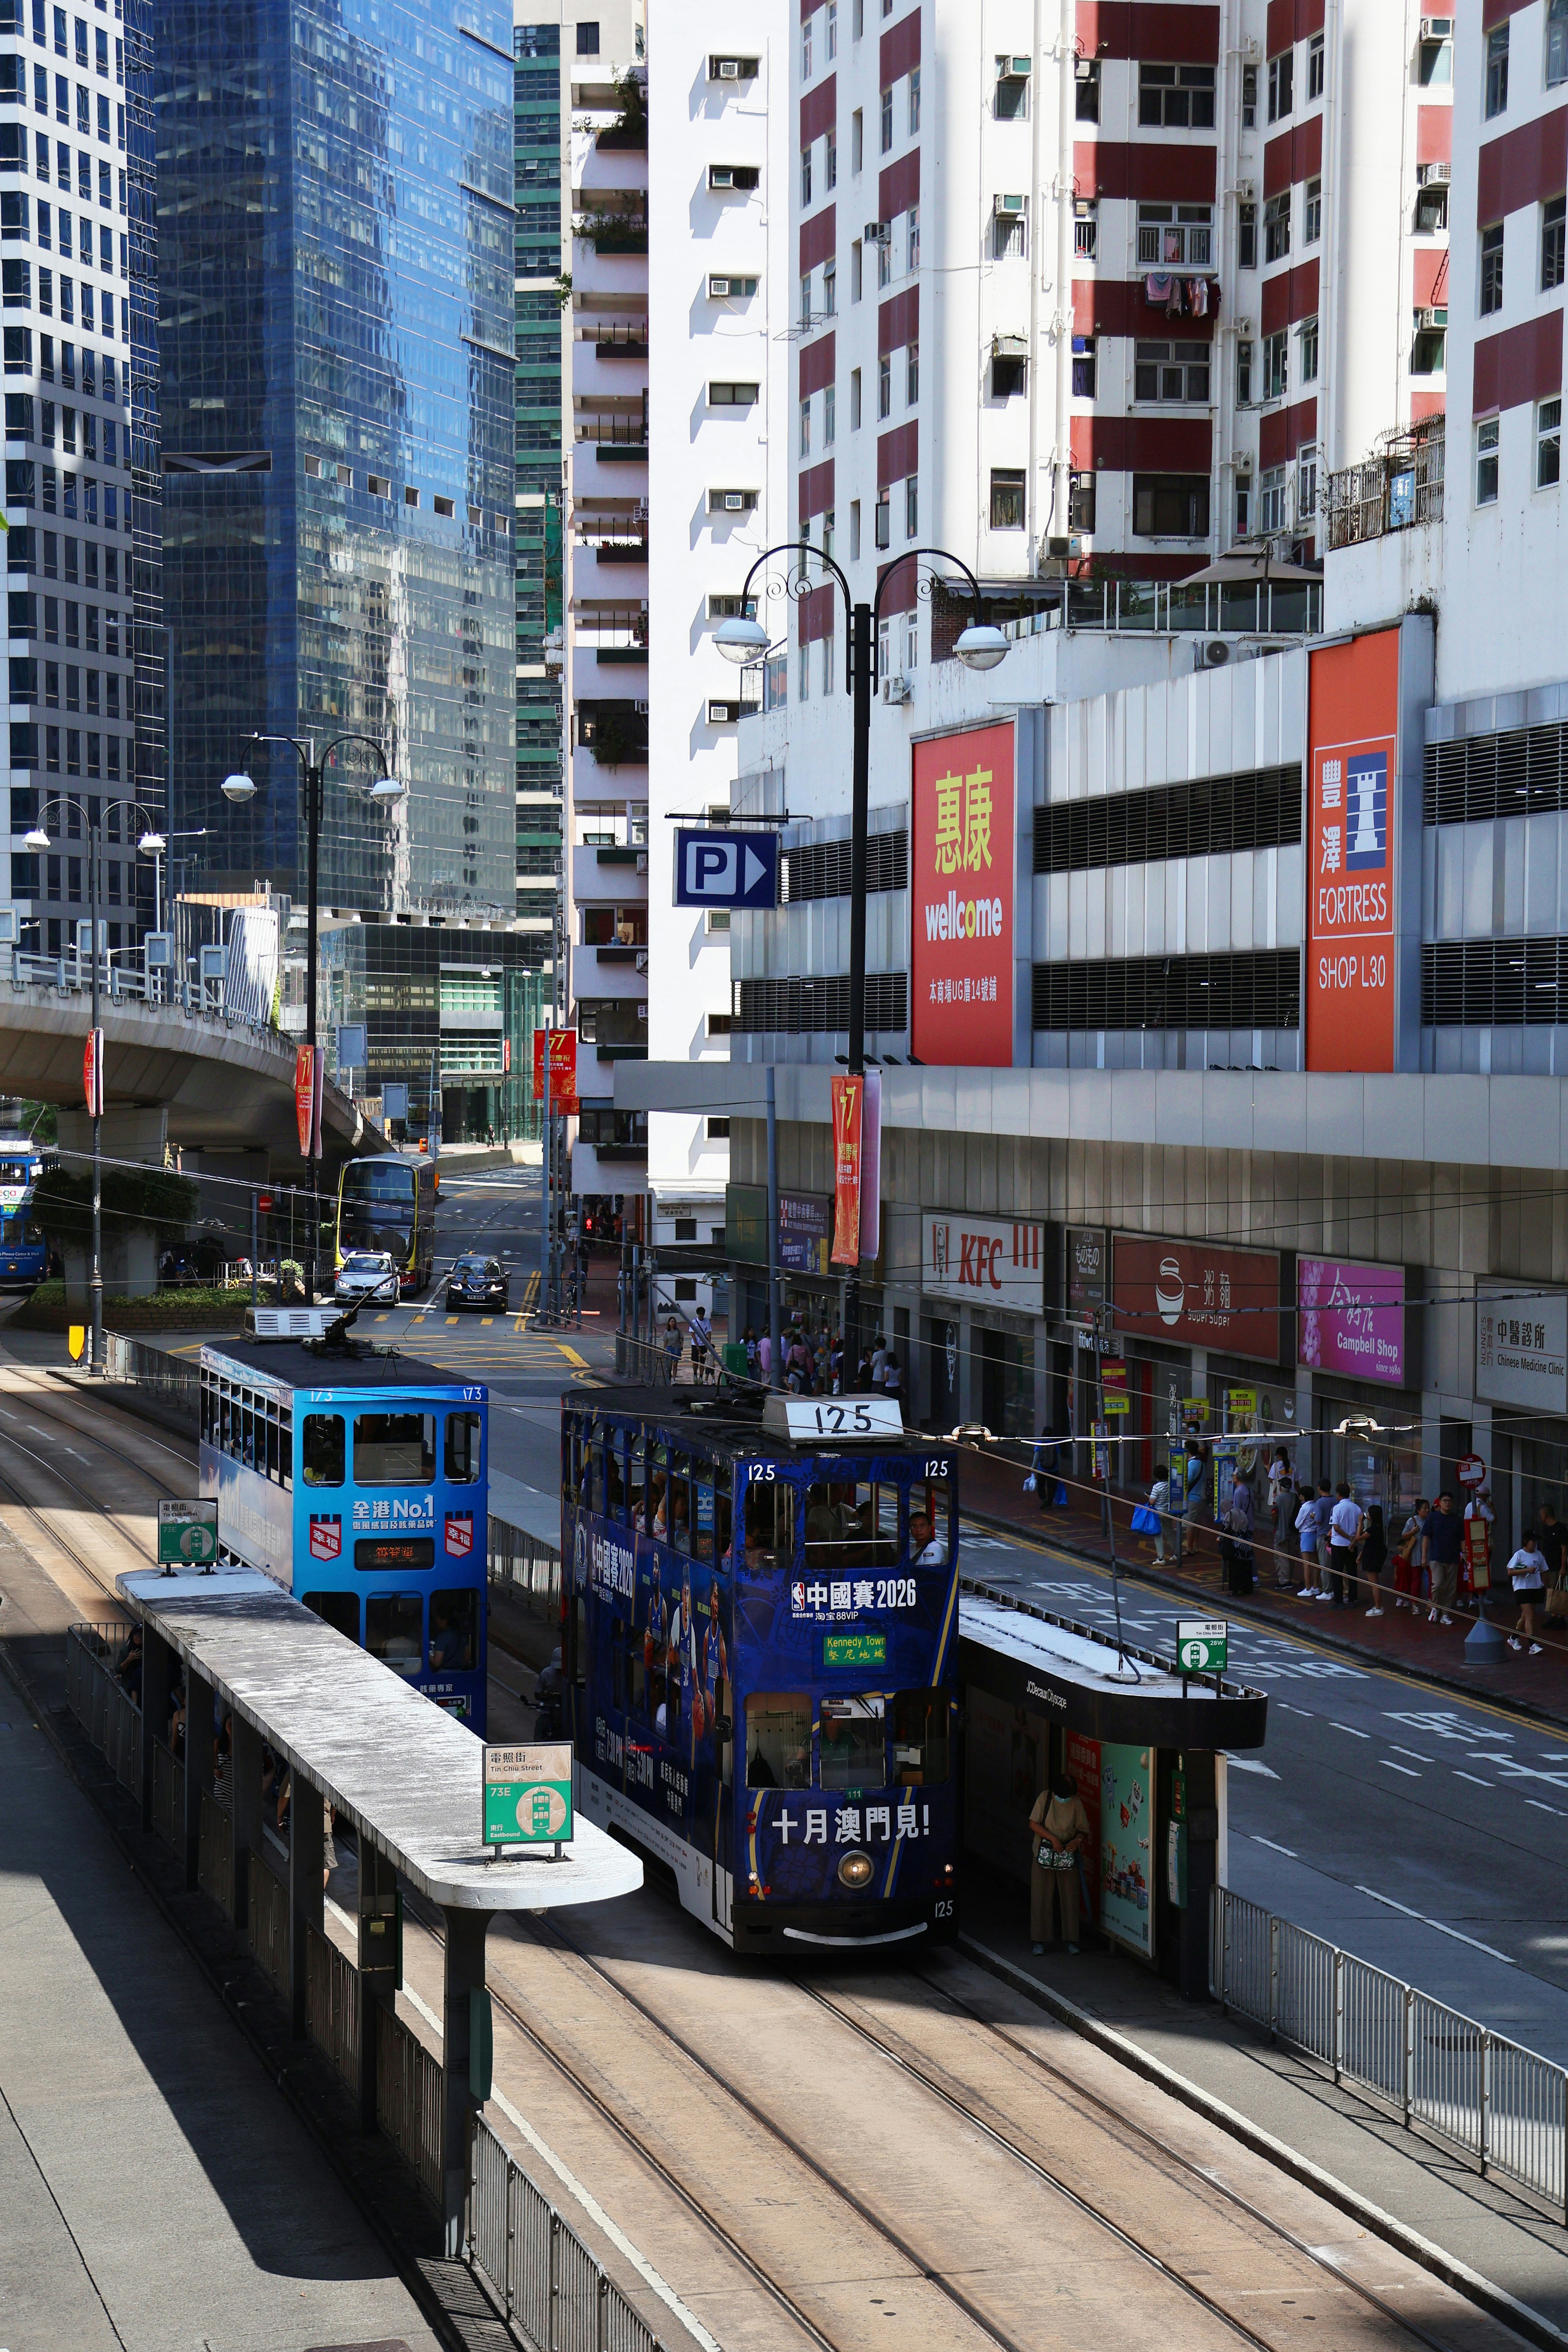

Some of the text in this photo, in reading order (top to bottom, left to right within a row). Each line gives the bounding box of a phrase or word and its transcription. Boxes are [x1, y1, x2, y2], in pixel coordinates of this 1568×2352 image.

[935, 764, 993, 874] 惠康
[1321, 760, 1342, 875] 豐澤
[695, 847, 727, 889] P
[926, 890, 1002, 942] wellcome
[1319, 883, 1387, 926] FORTRESS
[1319, 955, 1386, 990] SHOP L30
[929, 976, 997, 1004] 本商場UG層14號鋪
[302, 1051, 310, 1082] 77
[840, 1087, 857, 1130] 77
[958, 1234, 1003, 1290] KFC
[1188, 1270, 1230, 1308] 一粥麵
[1210, 1314, 1230, 1328] Super
[1497, 1319, 1545, 1350] 中醫診所
[1337, 1332, 1398, 1362] Campbell Shop
[1376, 1361, 1401, 1376] since 1980
[1497, 1354, 1564, 1376] Chinese Medicine Clinic
[311, 1389, 333, 1402] 173
[463, 1387, 481, 1400] 173
[815, 1405, 872, 1434] 125
[748, 1465, 775, 1481] 125
[925, 1460, 949, 1477] 125
[353, 1496, 434, 1519] 全港No.1
[313, 1529, 338, 1551] 幸福
[448, 1527, 471, 1548] 幸福
[827, 1636, 886, 1650] Kennedy Town
[829, 1647, 886, 1661] 堅尼地城
[1026, 1680, 1067, 1710] JCDecaux Cityscape
[490, 1752, 526, 1763] 電照街
[490, 1788, 511, 1797] 73E
[771, 1804, 929, 1845] 十月澳門見!
[935, 1900, 953, 1918] 125
